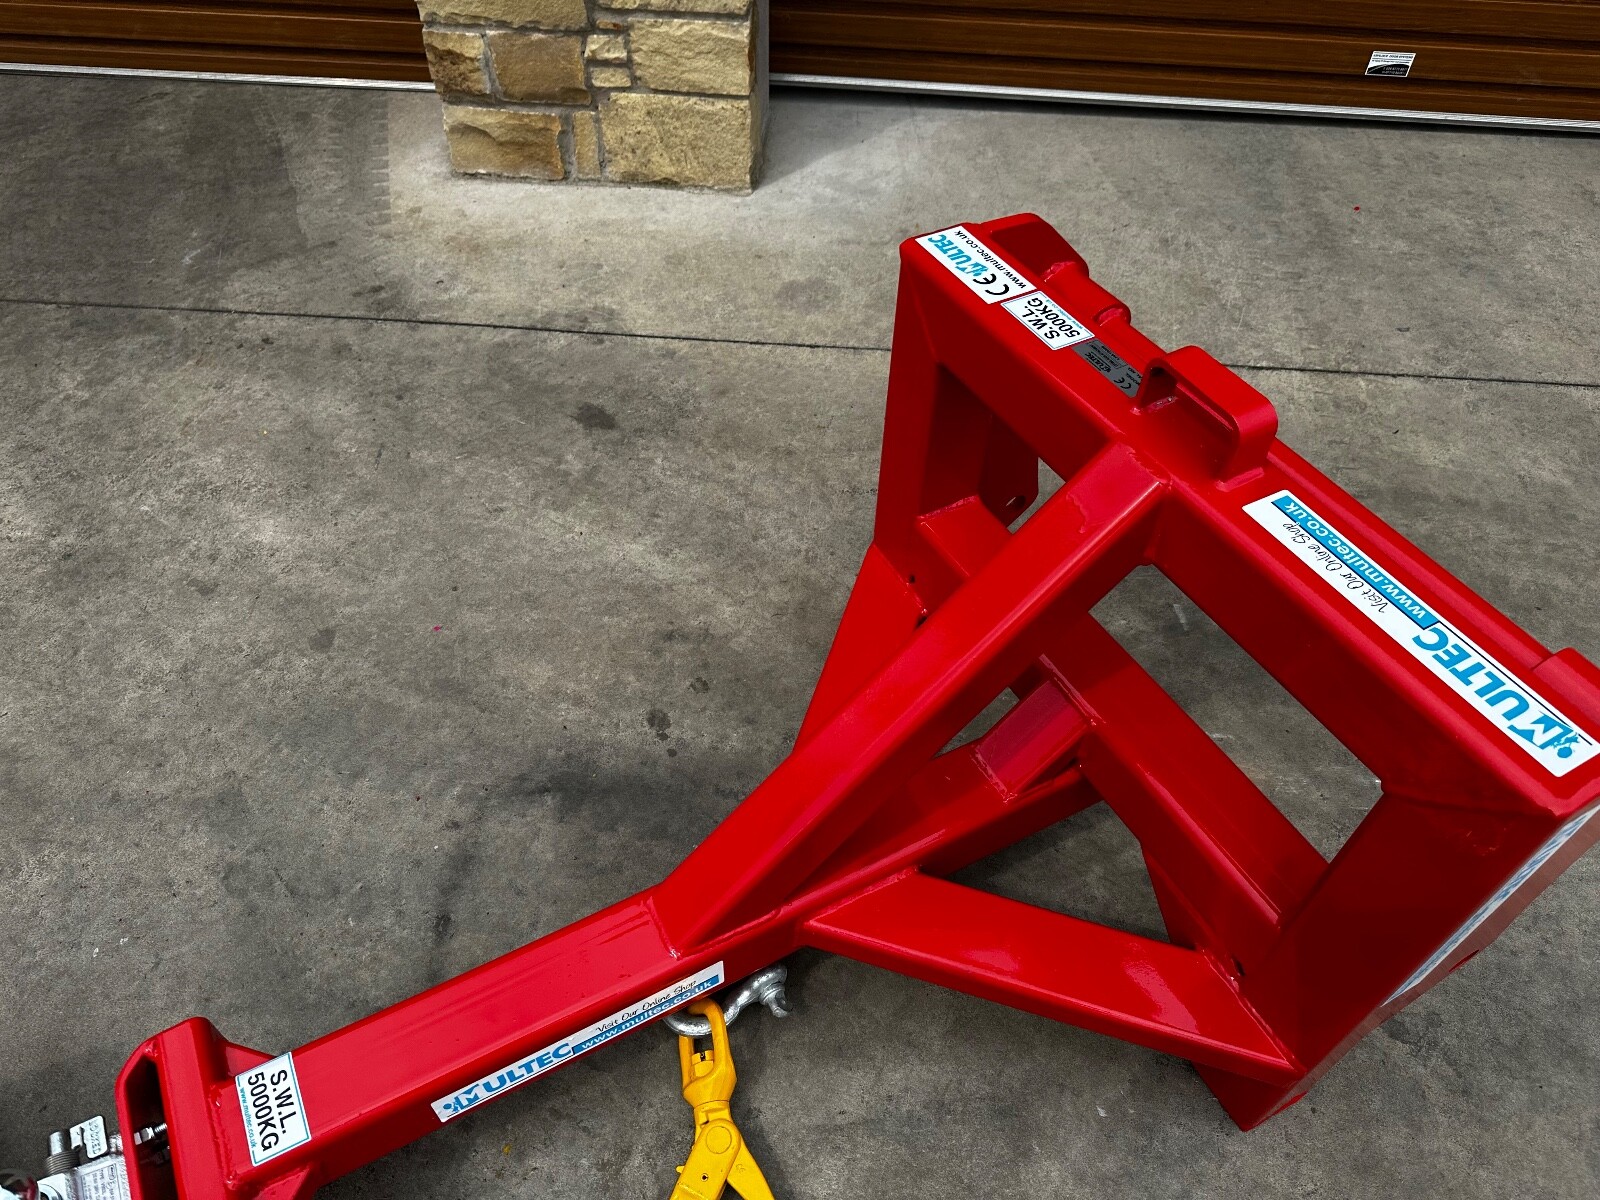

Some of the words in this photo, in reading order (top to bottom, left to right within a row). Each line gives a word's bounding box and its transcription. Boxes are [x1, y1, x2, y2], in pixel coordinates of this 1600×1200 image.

[928, 234, 988, 277] MULTEC
[954, 230, 1027, 288] www.multec.co.uk
[1022, 305, 1060, 339] S.W.L.
[1027, 297, 1080, 338] 5000KG
[1282, 521, 1311, 544] Shop
[1307, 543, 1343, 571] Online
[1284, 502, 1427, 619] www.multec.co.uk
[1340, 572, 1364, 590] Our
[1361, 588, 1389, 614] Visit
[1412, 627, 1575, 751] MULTEC
[595, 1019, 619, 1033] Visit
[621, 1008, 639, 1021] Our
[642, 993, 671, 1011] Online
[673, 980, 697, 995] Shop
[456, 1042, 573, 1111] MULTEC
[581, 980, 713, 1050] www.multec.co.uk
[239, 1087, 257, 1149] www.multec.co.uk
[247, 1071, 280, 1152] 5000KG
[270, 1069, 297, 1134] S.W.L.
